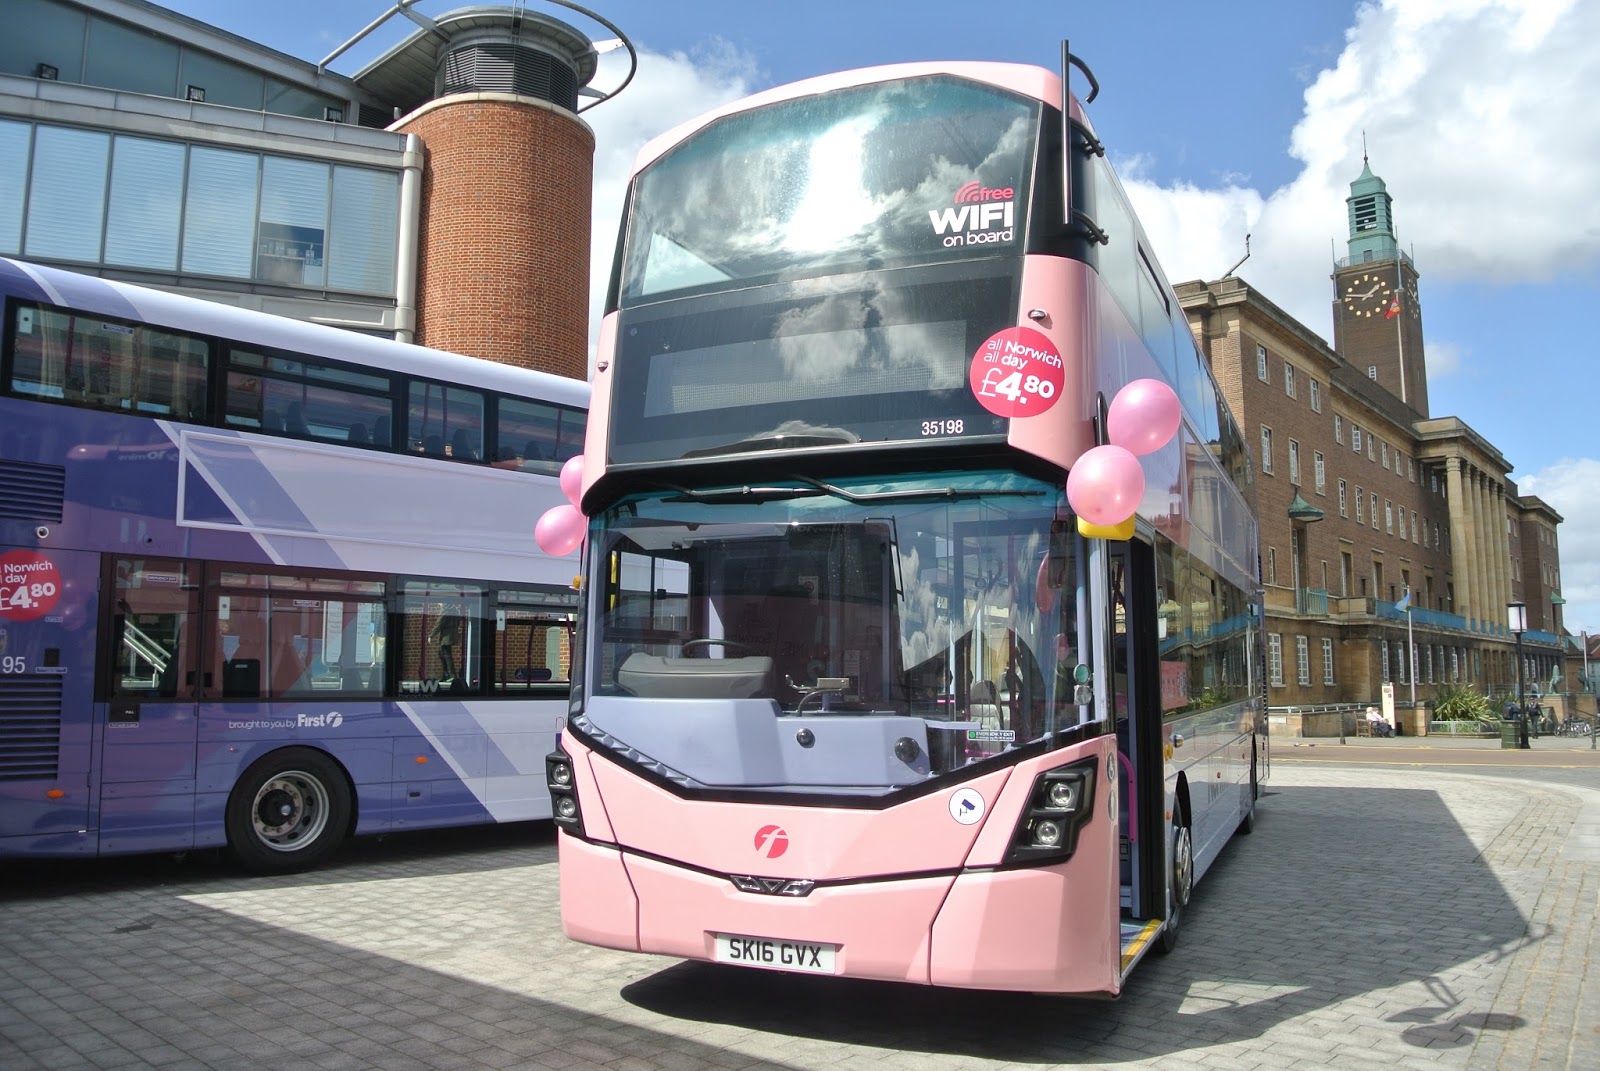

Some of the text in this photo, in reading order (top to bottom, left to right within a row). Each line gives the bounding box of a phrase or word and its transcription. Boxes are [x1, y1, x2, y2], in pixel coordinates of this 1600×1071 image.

[980, 188, 1014, 201] free
[928, 201, 1014, 235] WIFI
[943, 228, 1013, 248] on board
[984, 351, 1028, 370] all day
[987, 338, 1062, 369] all Norwich
[978, 367, 1055, 405] £4.80
[921, 419, 964, 436] 35198
[4, 561, 53, 573] Norwich
[5, 574, 27, 585] day
[228, 713, 325, 730] brought to you by First
[729, 938, 821, 967] SK16 GVX
